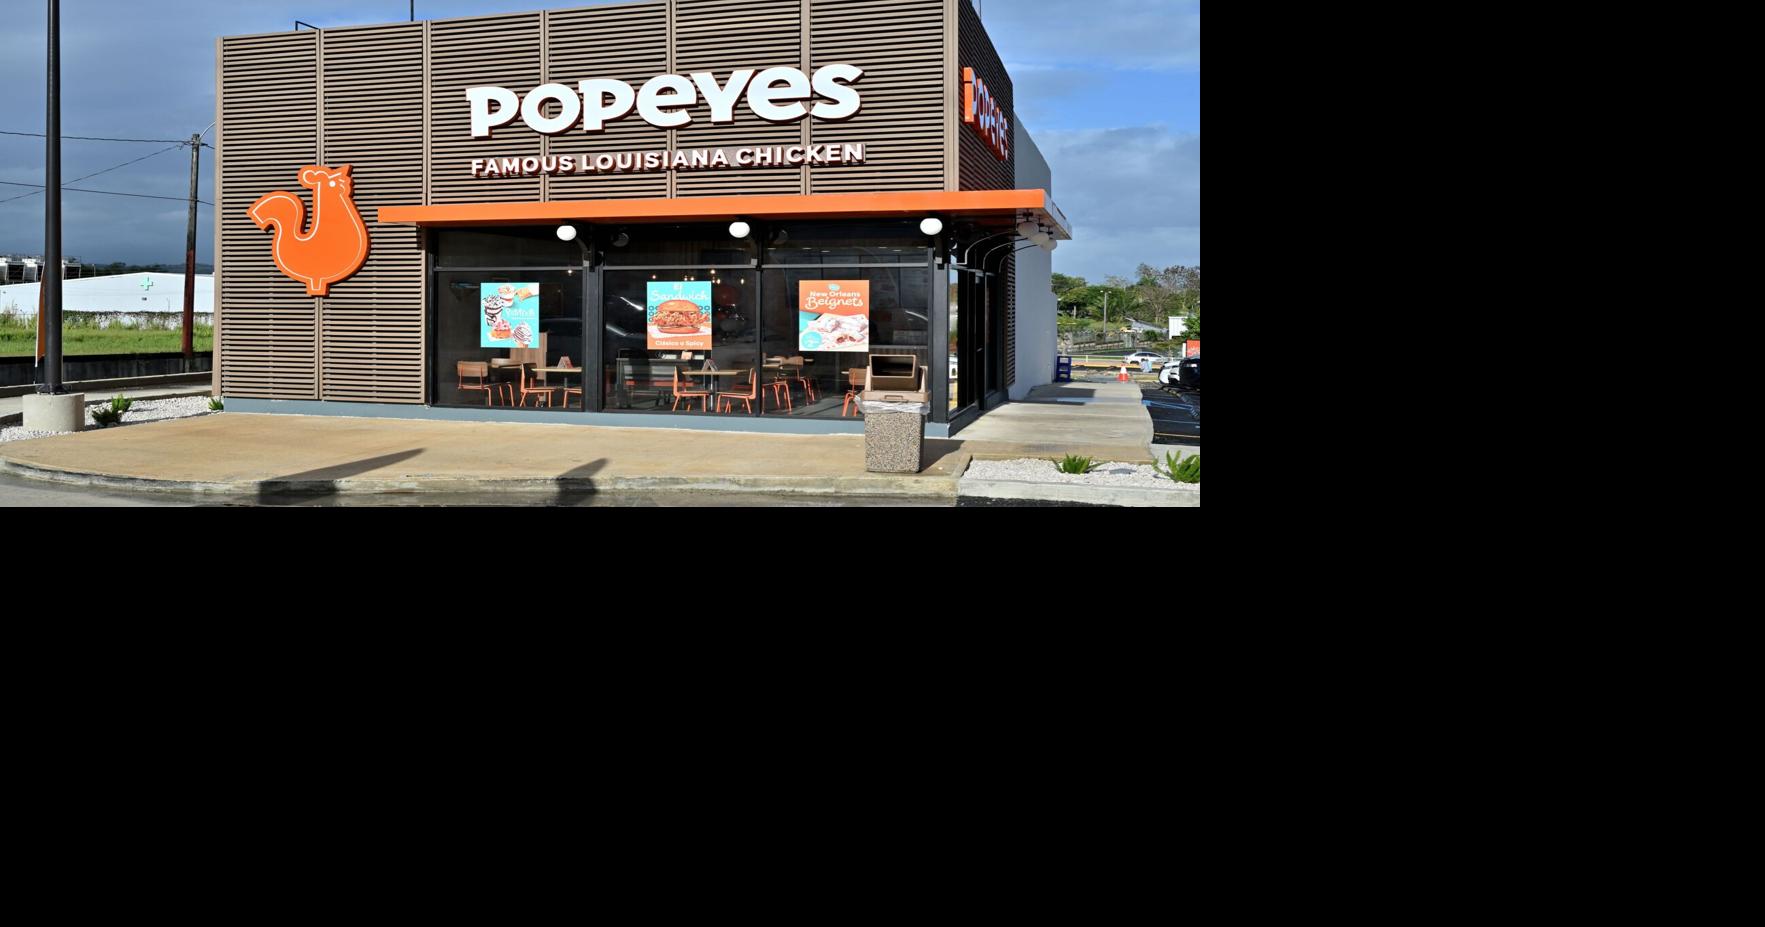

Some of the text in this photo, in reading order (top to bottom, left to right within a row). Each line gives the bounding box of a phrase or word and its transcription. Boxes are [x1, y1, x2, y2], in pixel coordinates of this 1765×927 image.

[471, 142, 865, 177] FAMOUS LOUISIANA CHICKEN
[650, 289, 709, 302] Sandwich
[829, 290, 861, 298] Orleans
[804, 296, 864, 310] Beignets
[686, 340, 705, 348] Spicy
